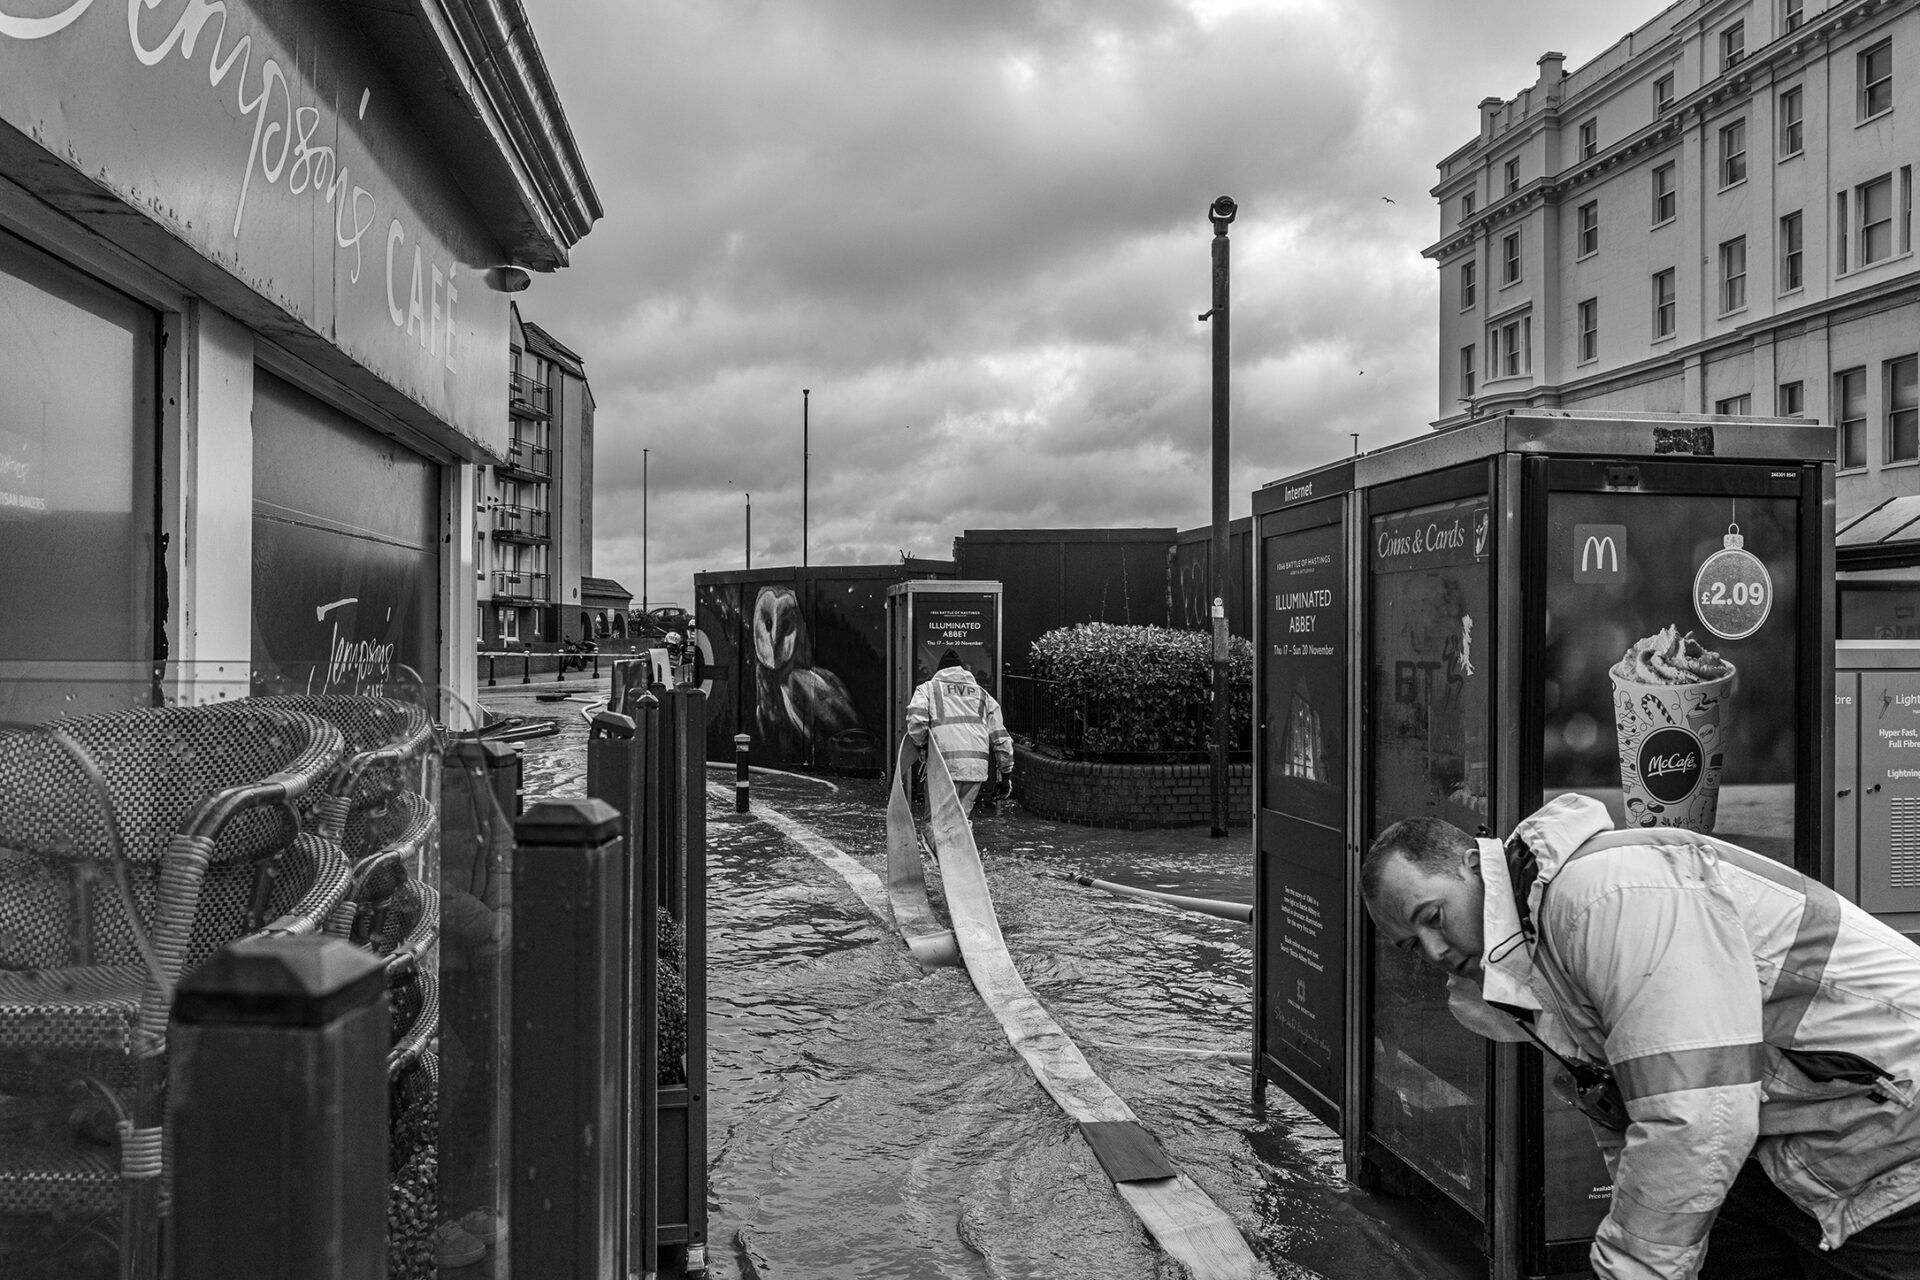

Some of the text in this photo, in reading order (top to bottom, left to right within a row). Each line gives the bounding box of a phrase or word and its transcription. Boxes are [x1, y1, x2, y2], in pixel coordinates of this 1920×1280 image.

[386, 219, 458, 375] CAFÉ
[1284, 481, 1313, 502] Internet
[1378, 520, 1465, 558] Coins & Cards
[1286, 559, 1301, 569] BATTLE
[1301, 558, 1307, 567] OF
[1308, 555, 1331, 566] HASTINGS
[1275, 589, 1332, 611] ILLUMINATED
[1701, 582, 1765, 606] £2.09
[929, 622, 981, 630] ILLUMINATED
[1289, 615, 1316, 632] ABBEY
[942, 630, 968, 638] ABBEY
[1273, 644, 1283, 655] Thu
[1283, 644, 1289, 655] 17
[1293, 644, 1301, 655] Sun
[1301, 644, 1308, 655] 20
[1309, 644, 1335, 655] November
[947, 684, 976, 697] HVP
[1879, 728, 1918, 739] Hyper Fast,
[1888, 740, 1902, 748] Full
